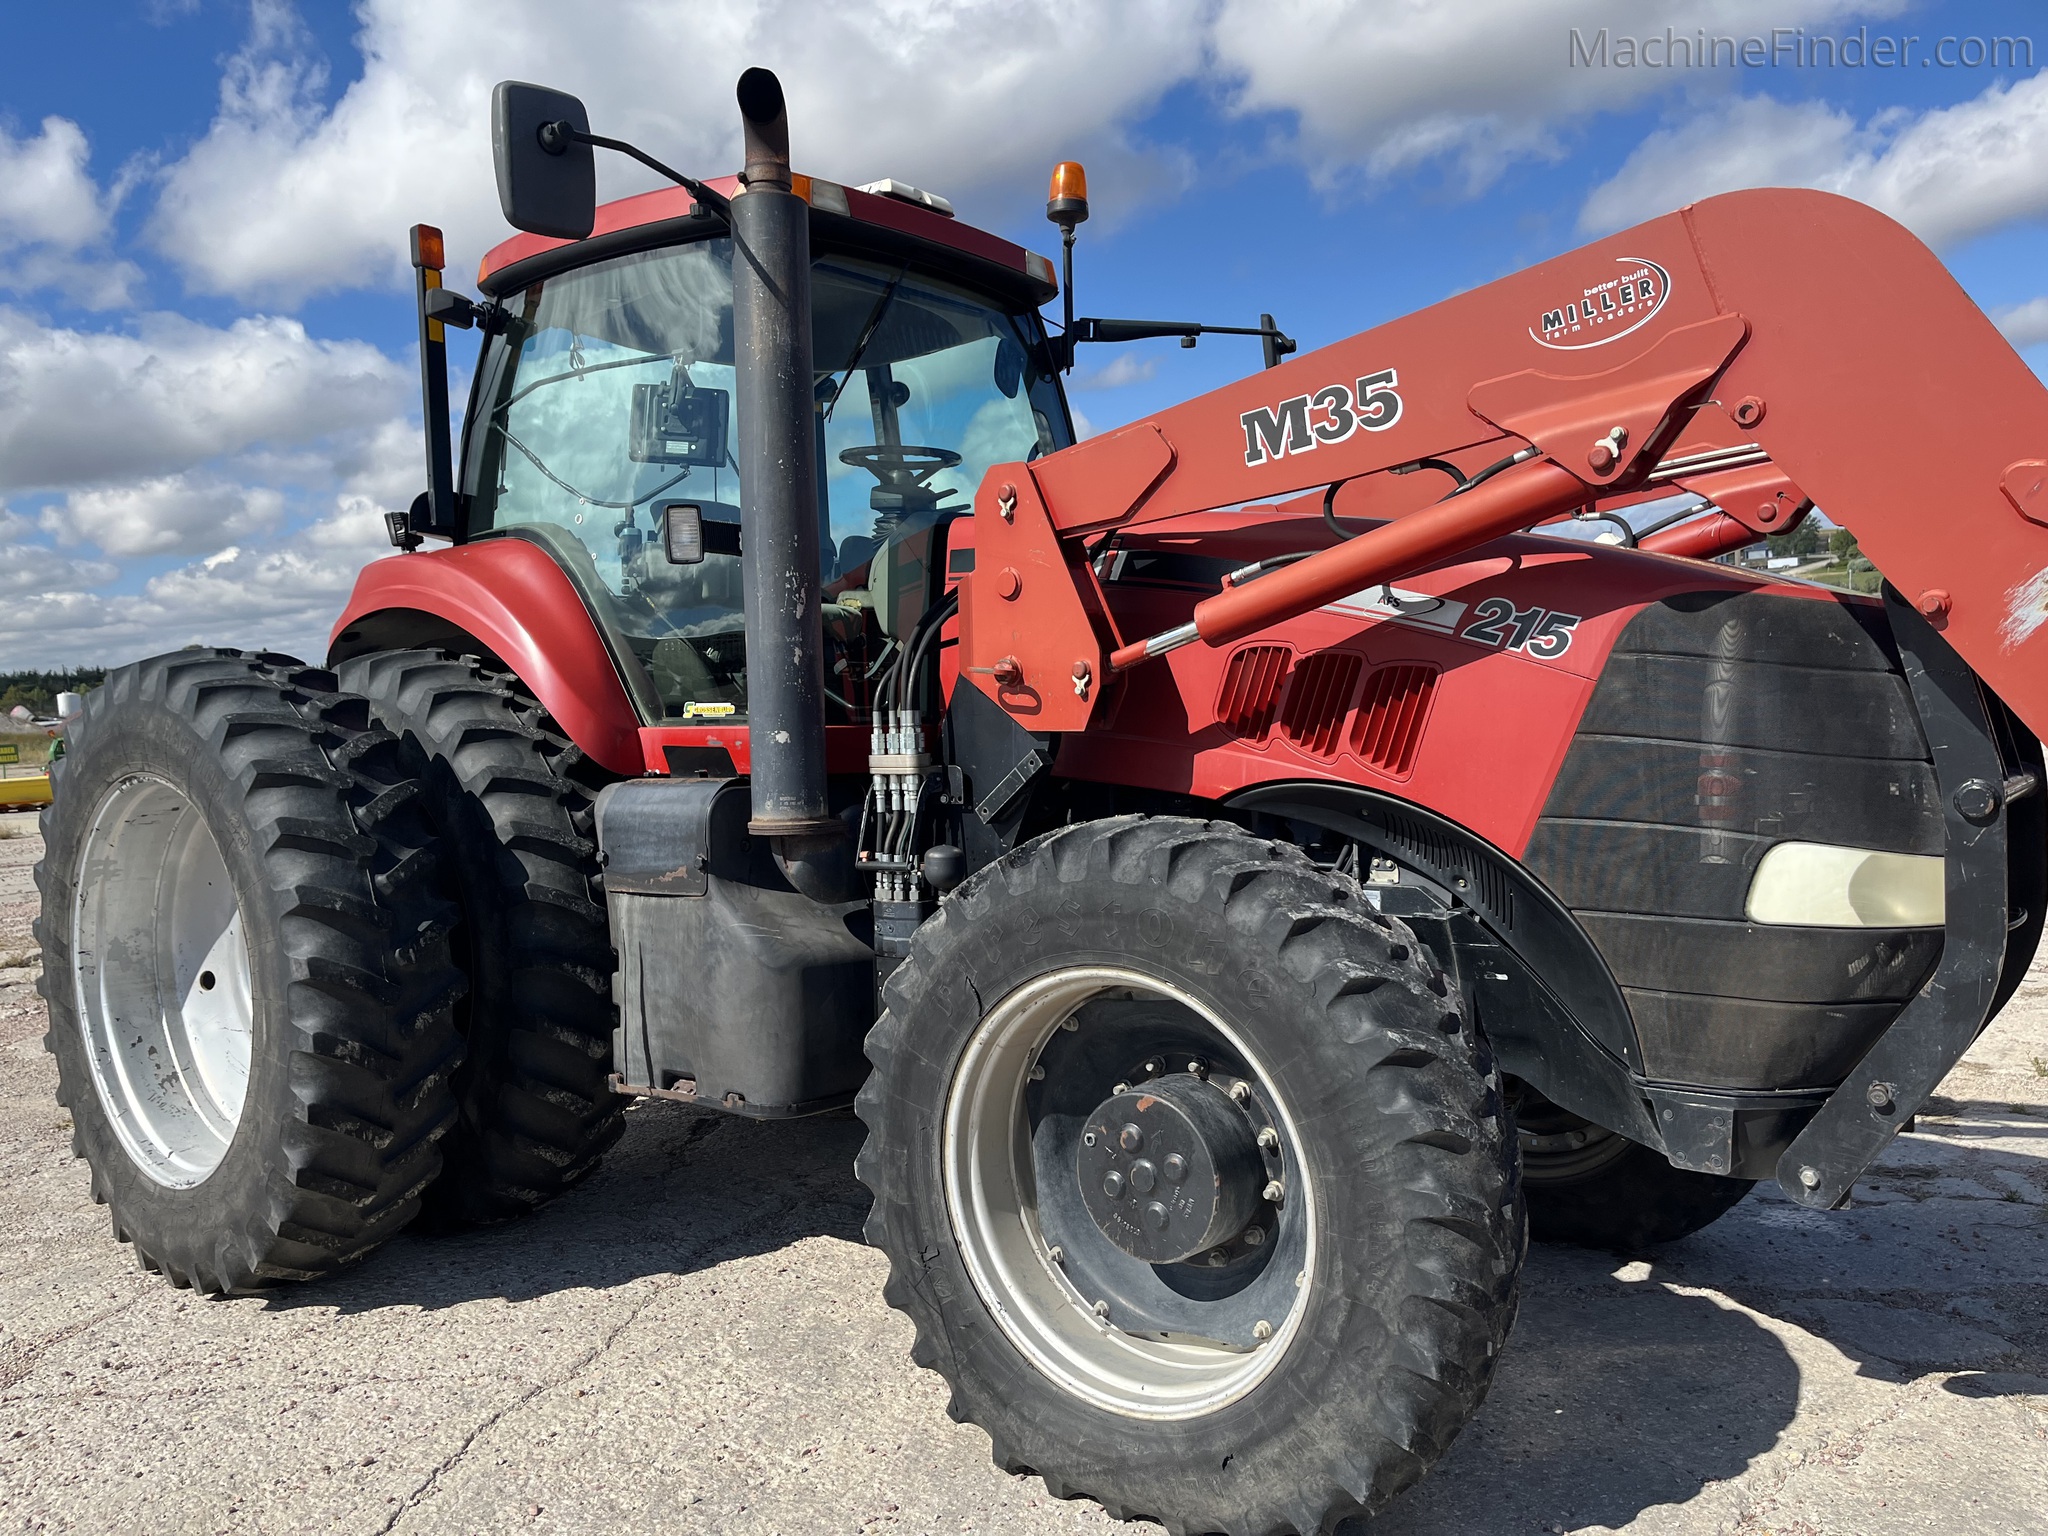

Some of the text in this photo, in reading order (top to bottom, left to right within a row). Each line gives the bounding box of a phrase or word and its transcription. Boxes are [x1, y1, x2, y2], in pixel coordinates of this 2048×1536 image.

[1542, 278, 1656, 333] MILLER
[1583, 267, 1649, 297] better built
[1545, 299, 1653, 341] farm loaders
[1240, 367, 1404, 468] M35
[1377, 594, 1401, 608] AFS
[1460, 597, 1583, 660] 215
